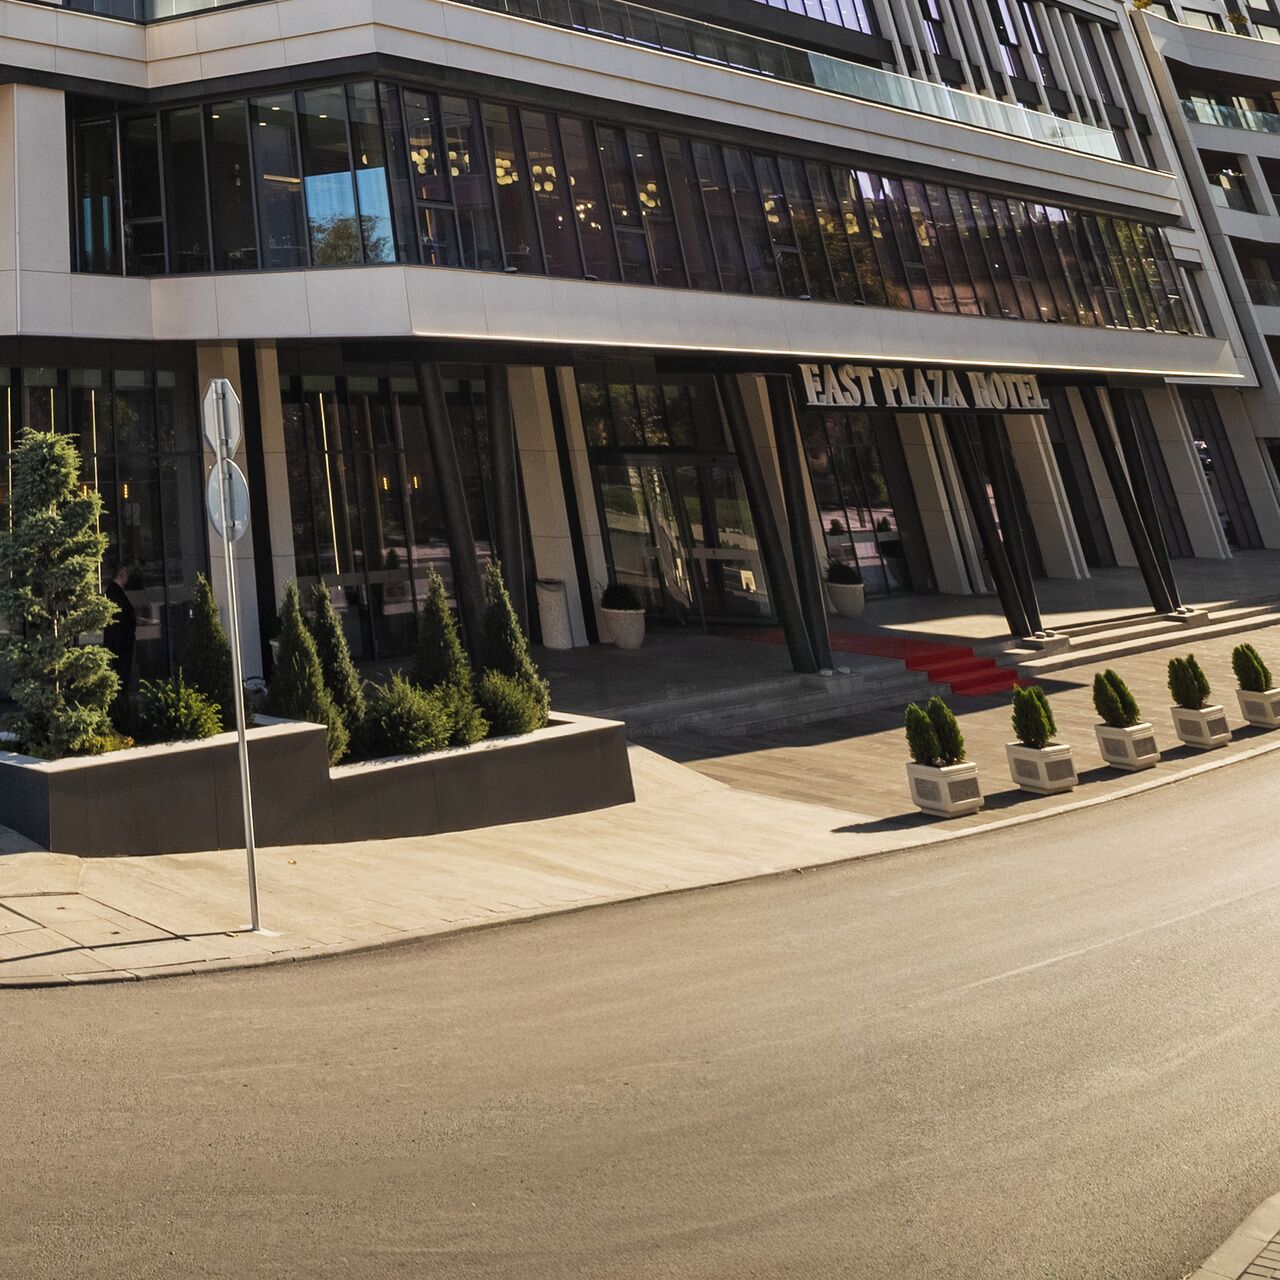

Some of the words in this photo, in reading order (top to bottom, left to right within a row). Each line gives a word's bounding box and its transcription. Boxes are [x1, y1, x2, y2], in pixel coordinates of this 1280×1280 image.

[798, 362, 878, 408] EAST
[878, 366, 970, 409] PLAZA
[966, 370, 1051, 410] HOTEL
